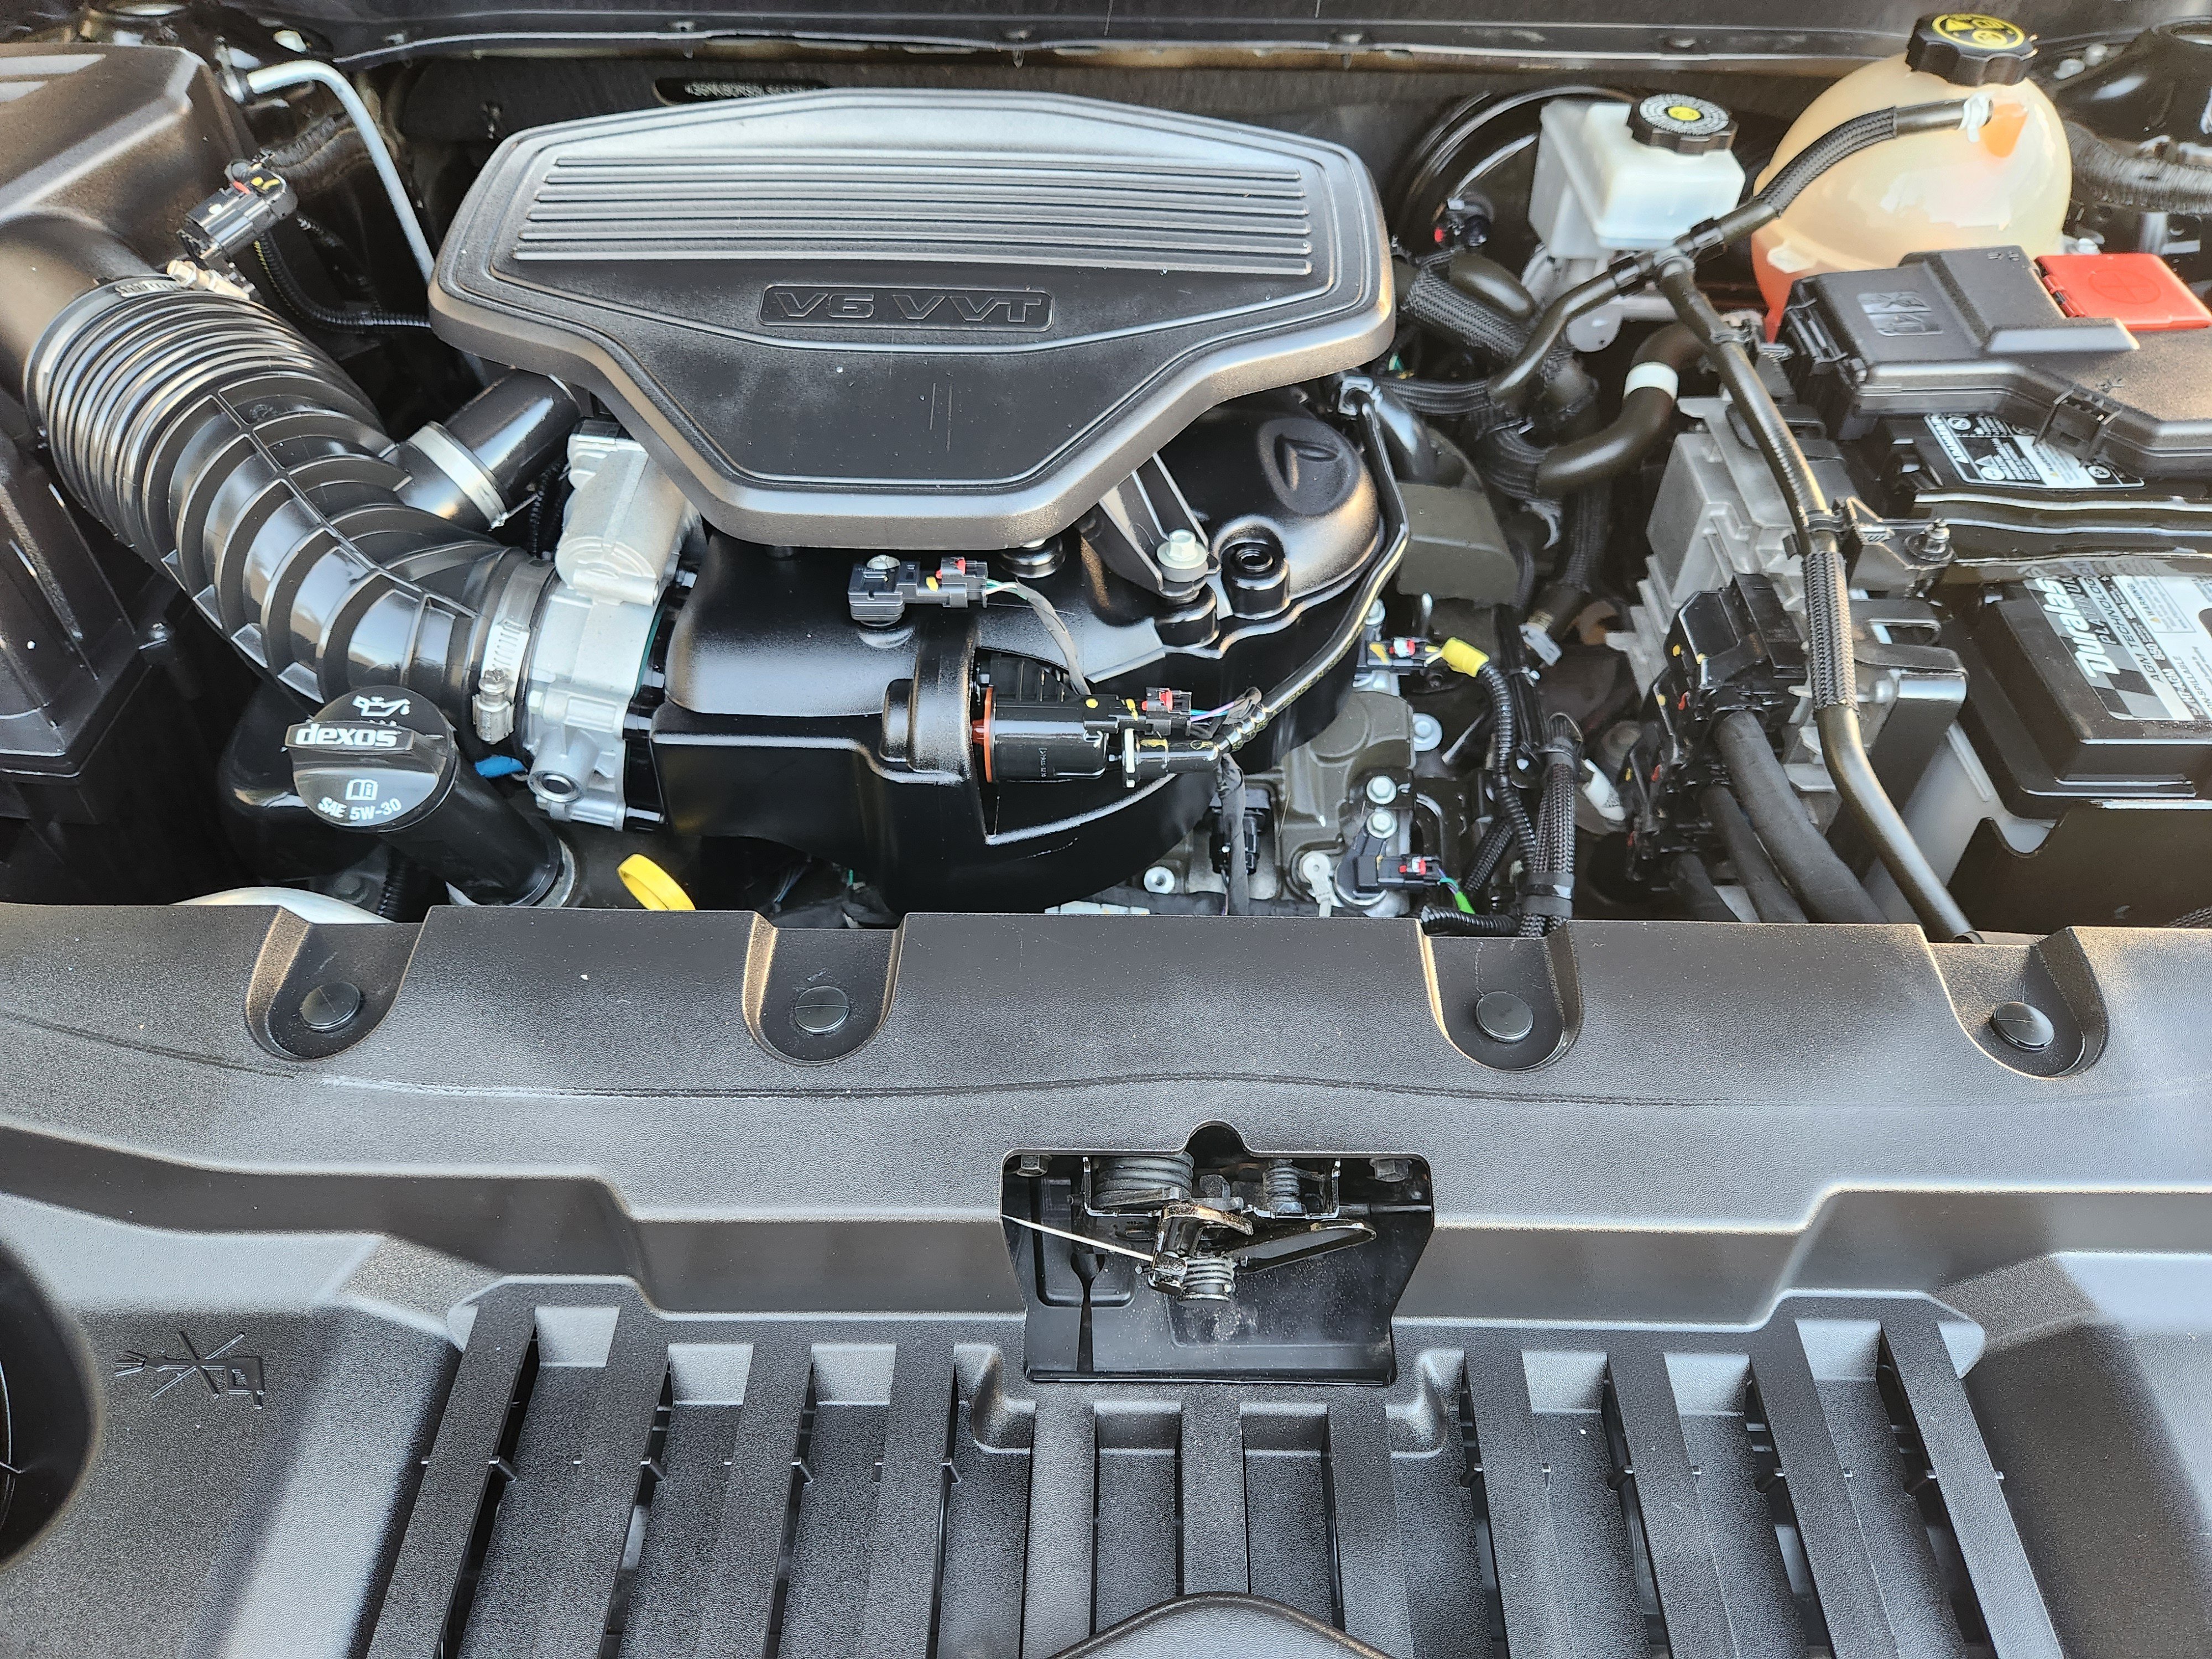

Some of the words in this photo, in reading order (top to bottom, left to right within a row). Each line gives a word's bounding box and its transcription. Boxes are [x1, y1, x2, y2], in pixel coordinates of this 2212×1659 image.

[775, 293, 875, 318] V6
[893, 294, 1041, 322] VVT
[2035, 576, 2121, 678] Duralas
[2084, 577, 2139, 649] TECHNOLOG
[2145, 643, 2166, 660] 850
[2135, 653, 2164, 684] AGM
[2173, 656, 2212, 713] ON-SPILLABLE
[296, 723, 398, 747] dexos
[317, 797, 348, 818] SAE
[349, 797, 403, 821] 5W-30
